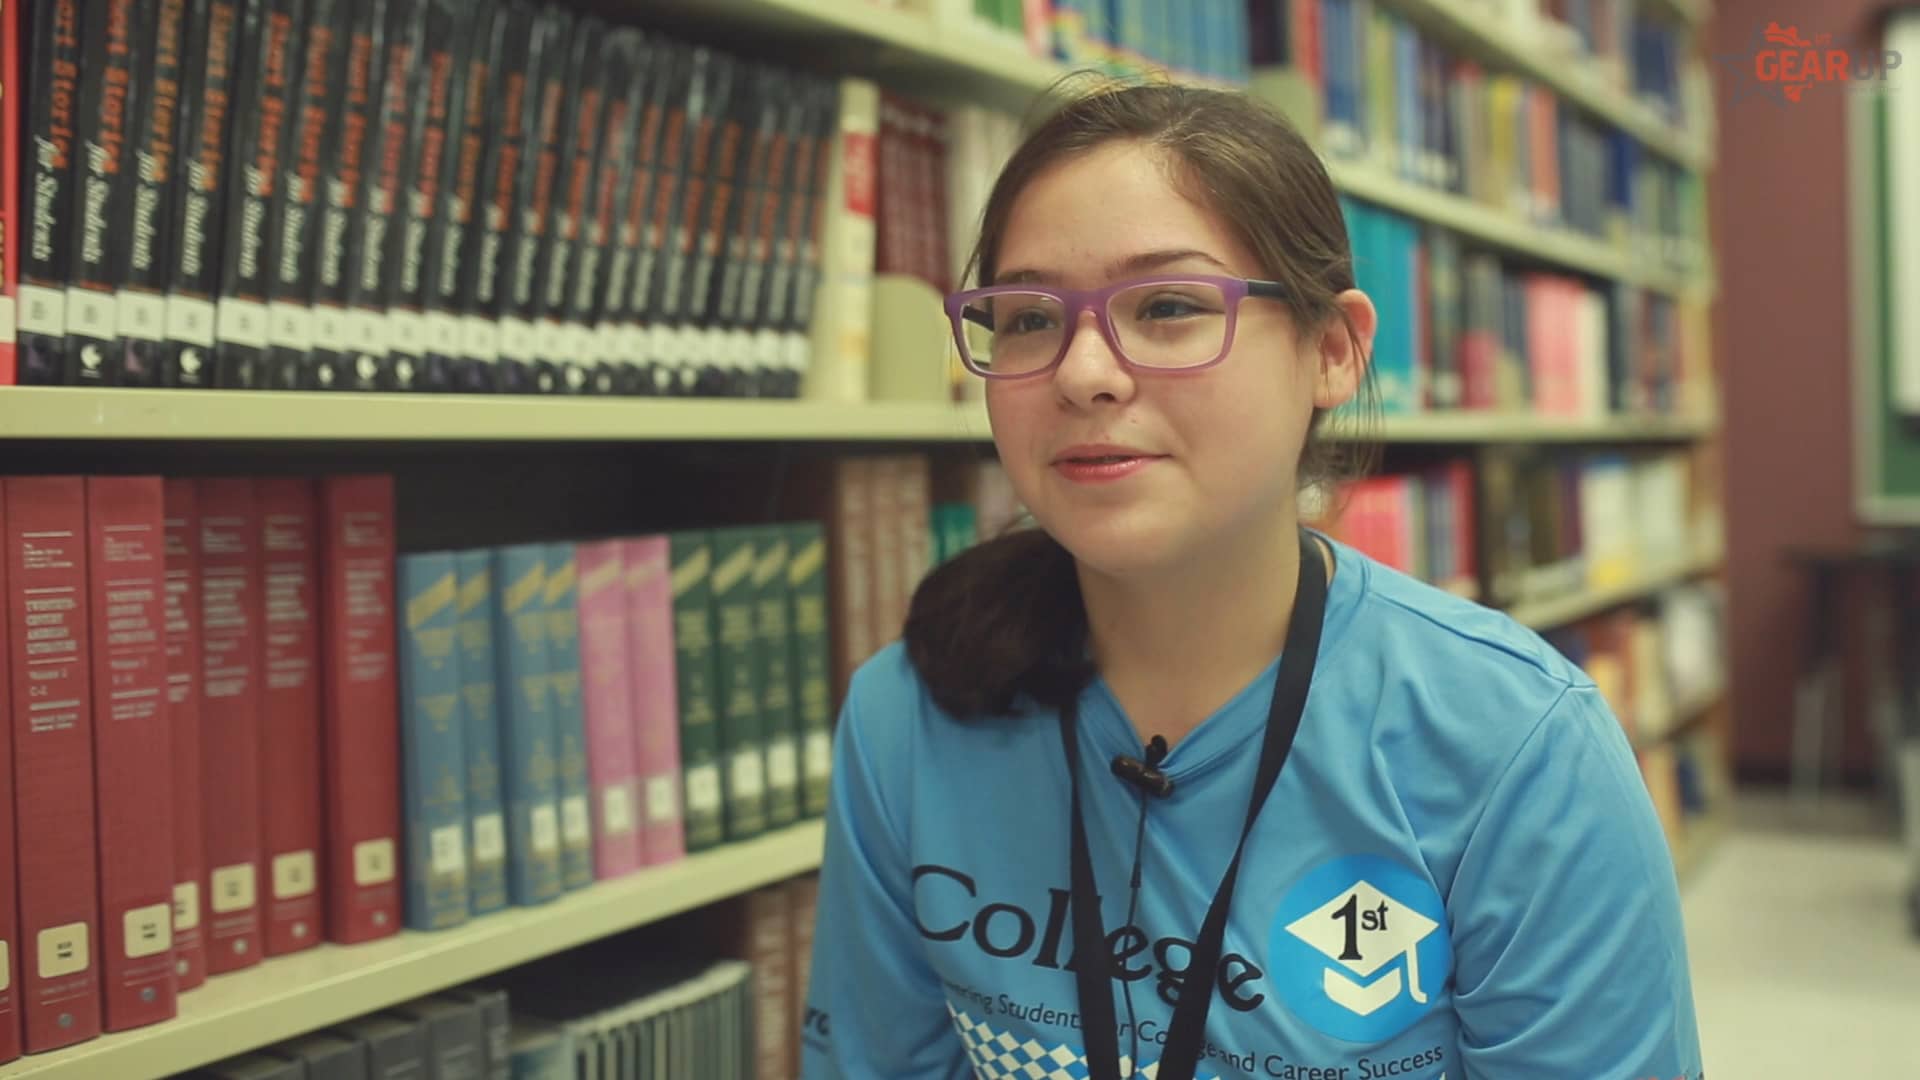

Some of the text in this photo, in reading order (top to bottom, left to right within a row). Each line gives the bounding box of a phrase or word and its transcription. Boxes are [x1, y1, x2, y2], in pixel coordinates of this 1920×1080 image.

[32, 172, 58, 261] Students
[82, 176, 110, 263] Students
[132, 184, 158, 269] Students
[1331, 894, 1389, 961] 1st
[998, 993, 1083, 1032] Student
[1218, 1050, 1256, 1073] and
[1264, 1054, 1350, 1080] Career
[1358, 1045, 1444, 1080] Success
